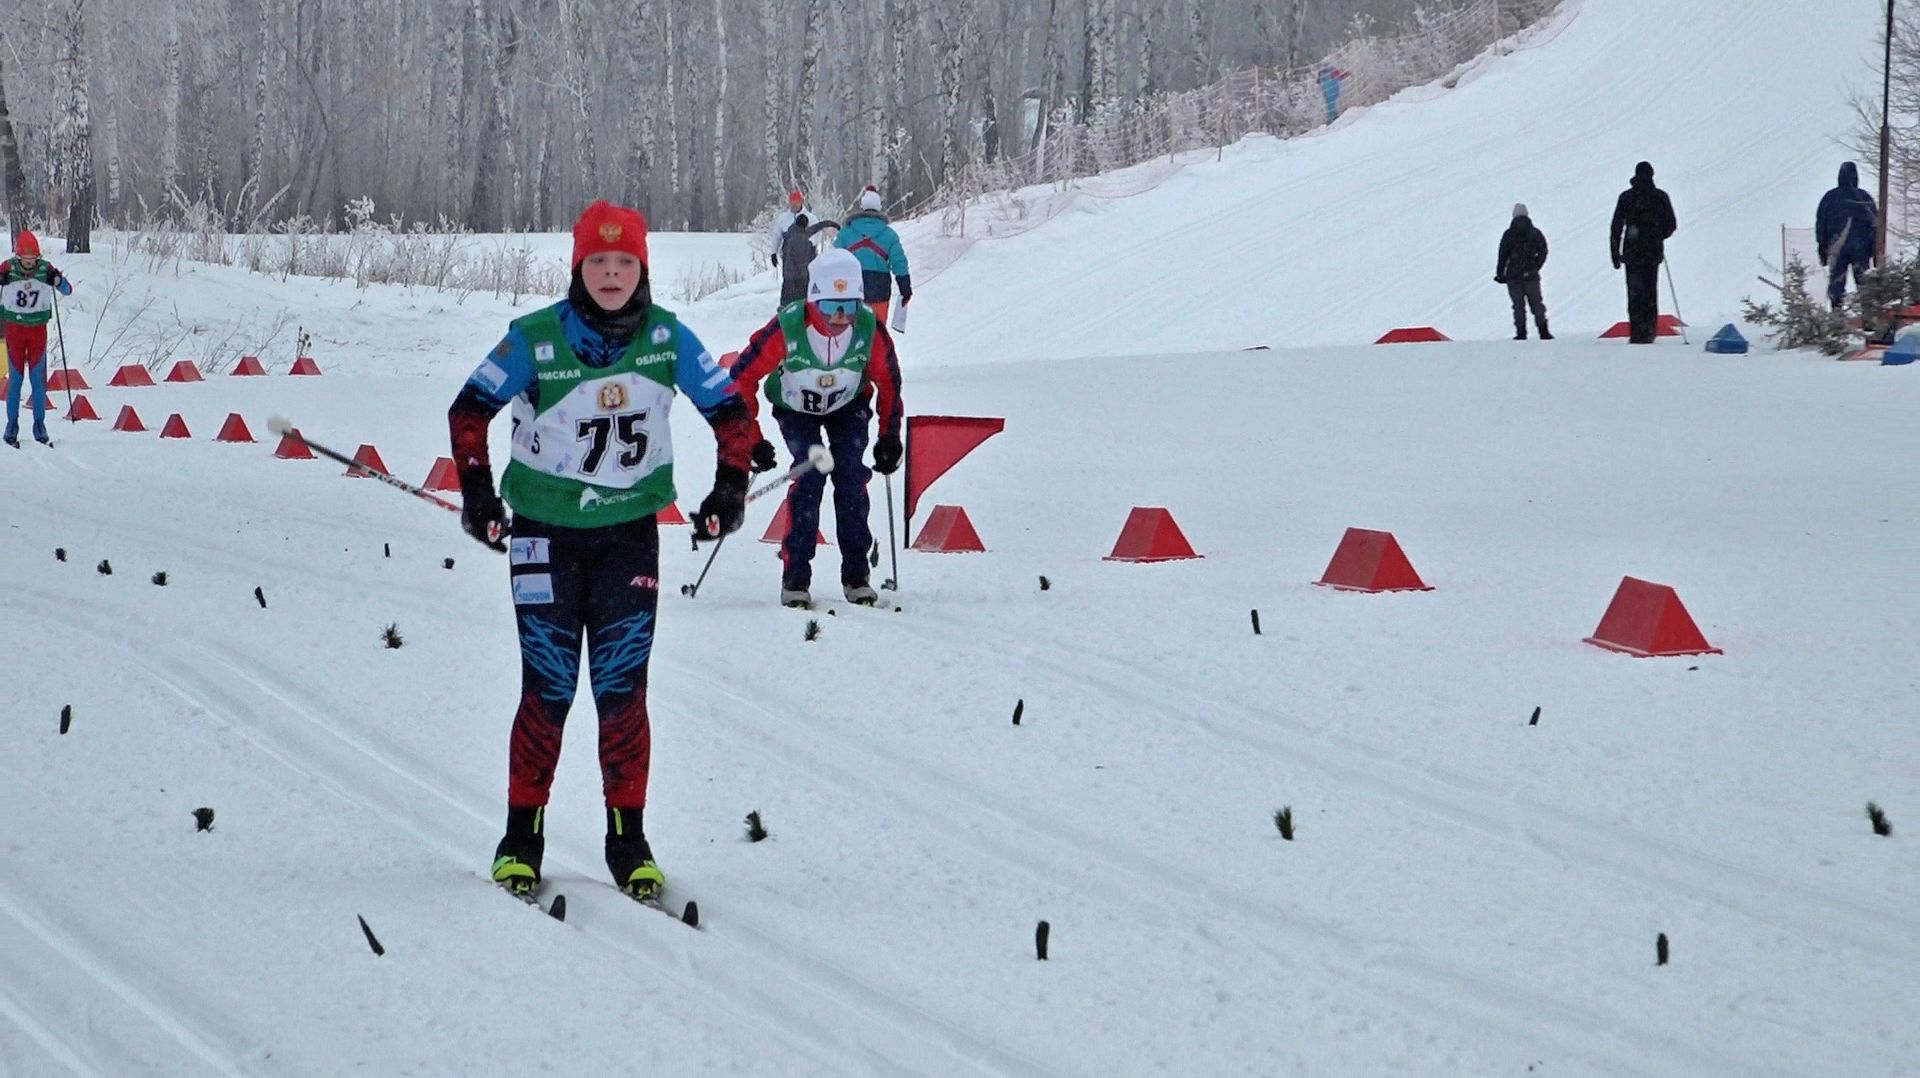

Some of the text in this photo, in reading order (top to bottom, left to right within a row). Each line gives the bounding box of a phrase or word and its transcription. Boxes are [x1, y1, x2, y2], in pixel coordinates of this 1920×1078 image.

[16, 290, 39, 308] 87
[635, 351, 677, 366] ОБЛАСТЬ
[576, 410, 649, 476] 75
